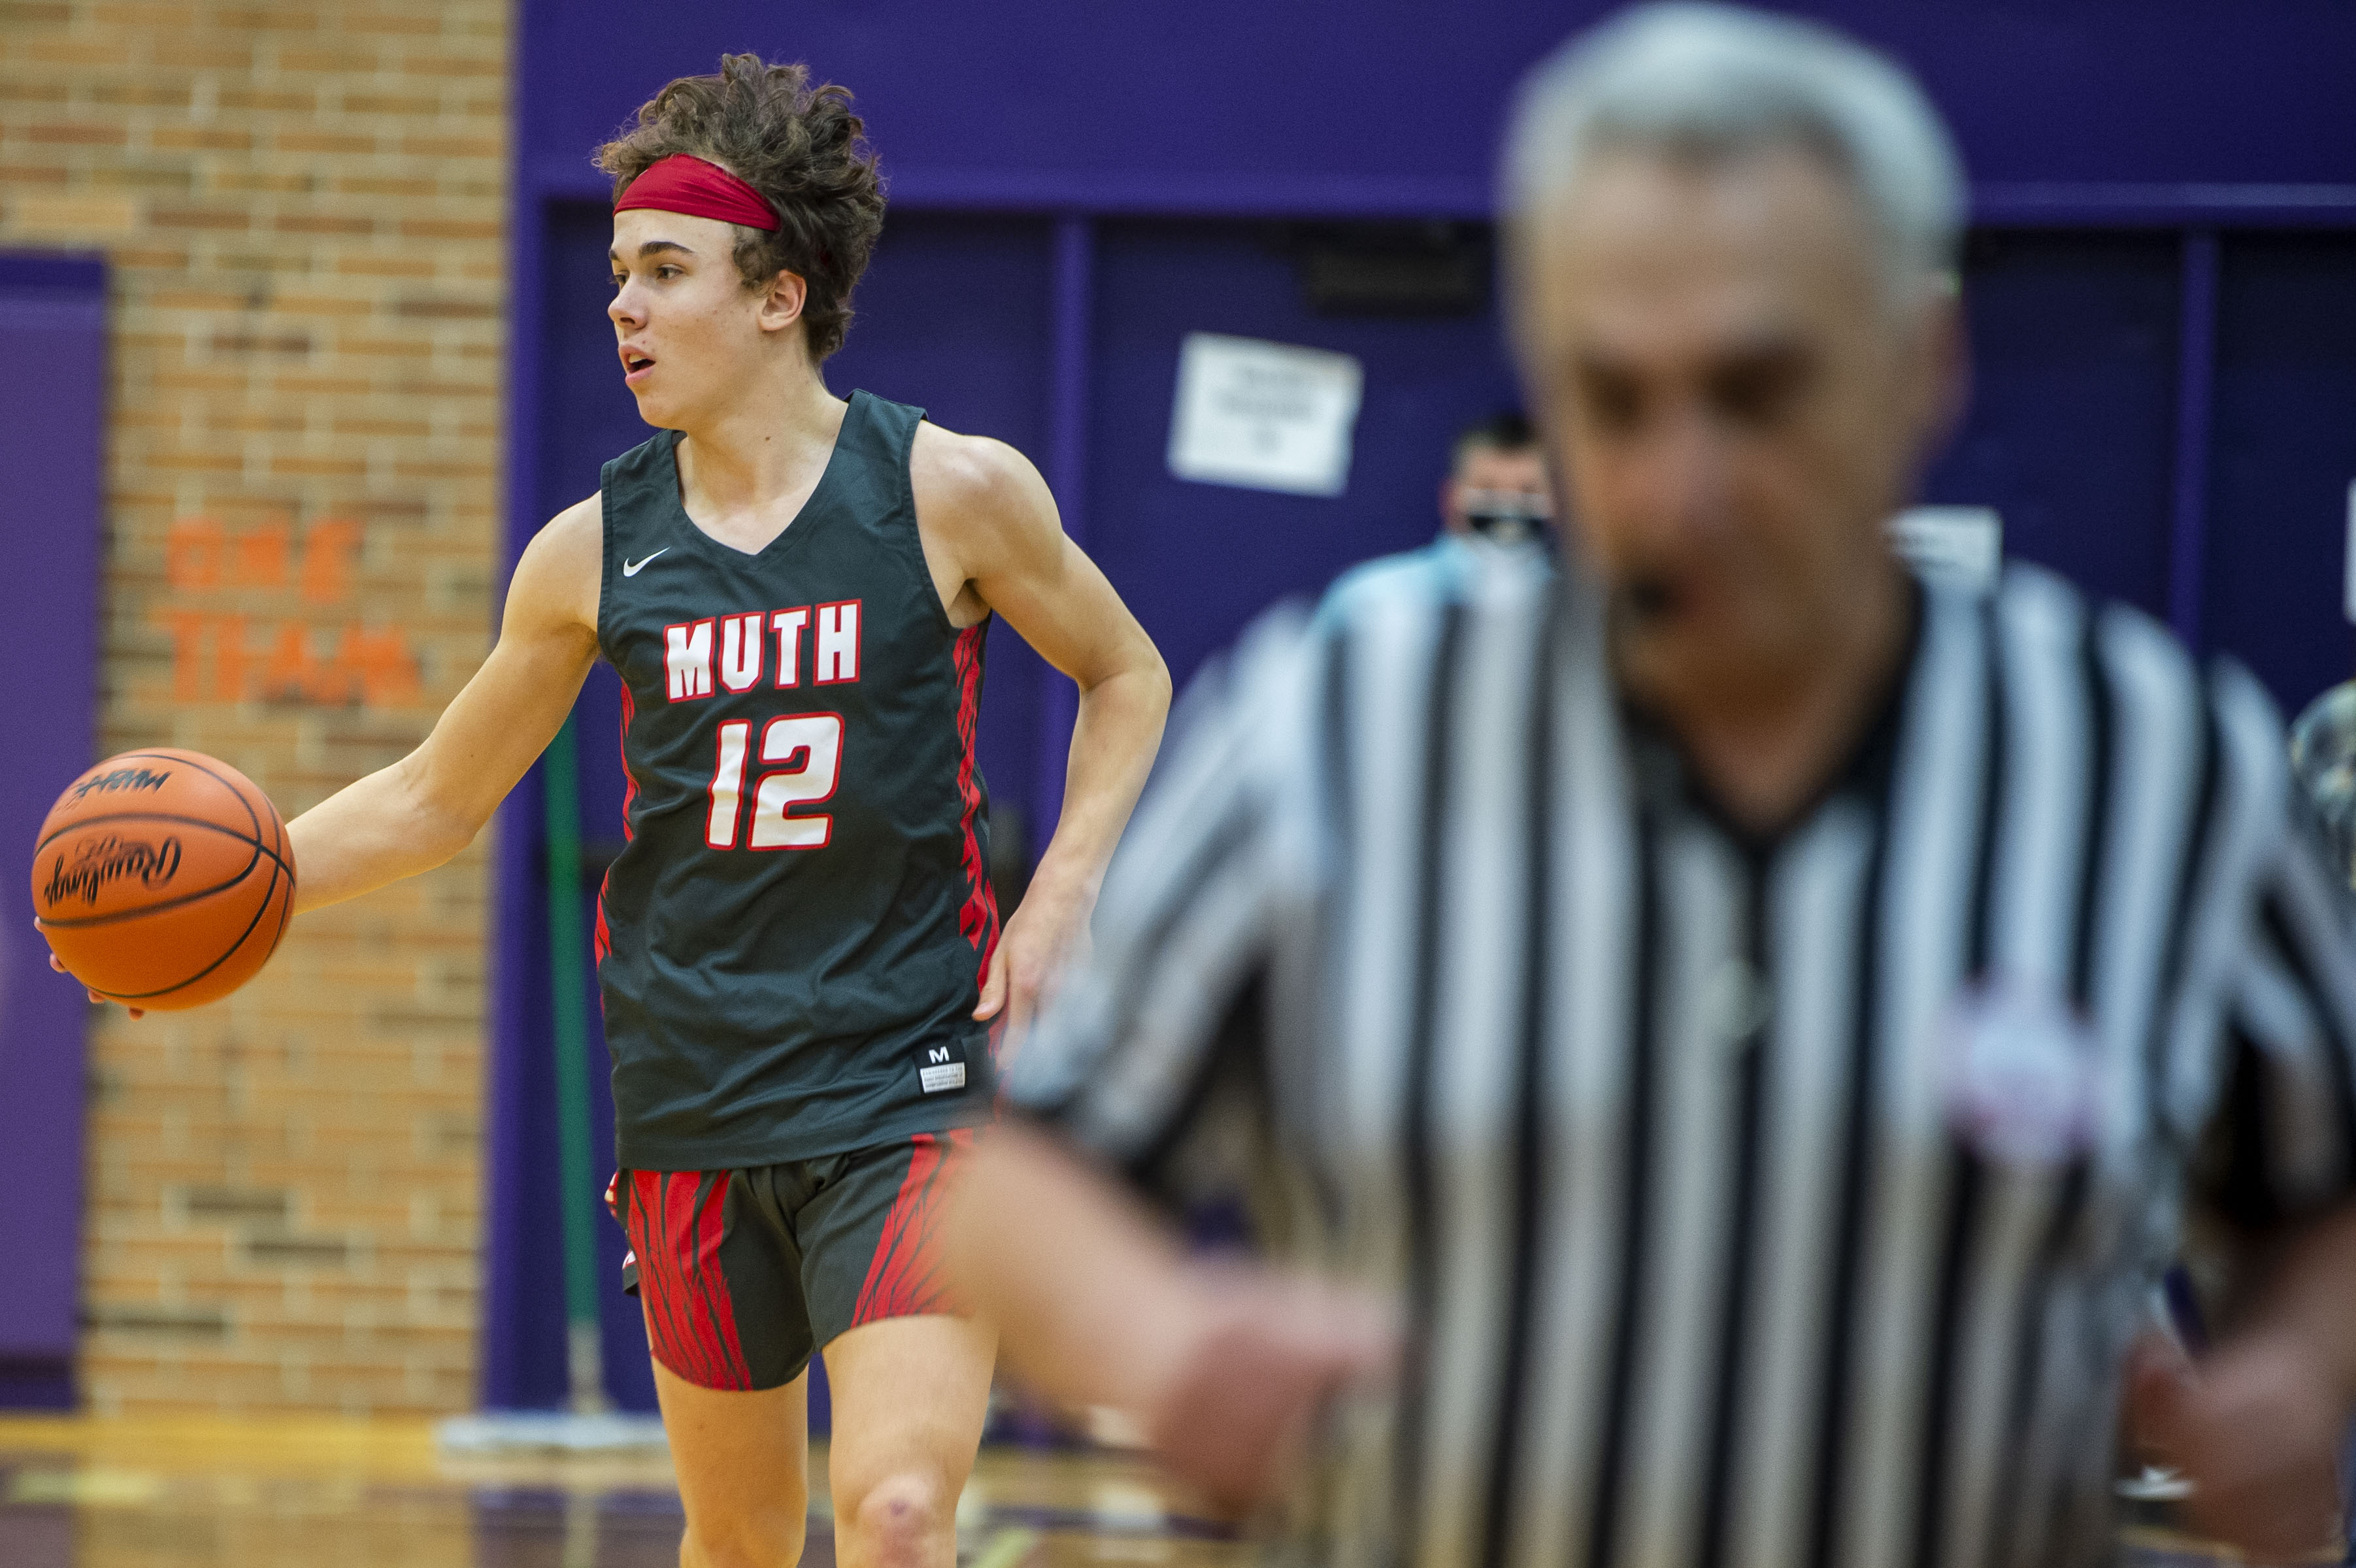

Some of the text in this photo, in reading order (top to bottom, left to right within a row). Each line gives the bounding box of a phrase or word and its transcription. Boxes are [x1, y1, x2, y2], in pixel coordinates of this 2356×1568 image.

[663, 599, 862, 703] MUTH
[705, 711, 845, 852] 12
[929, 1046, 950, 1064] M
